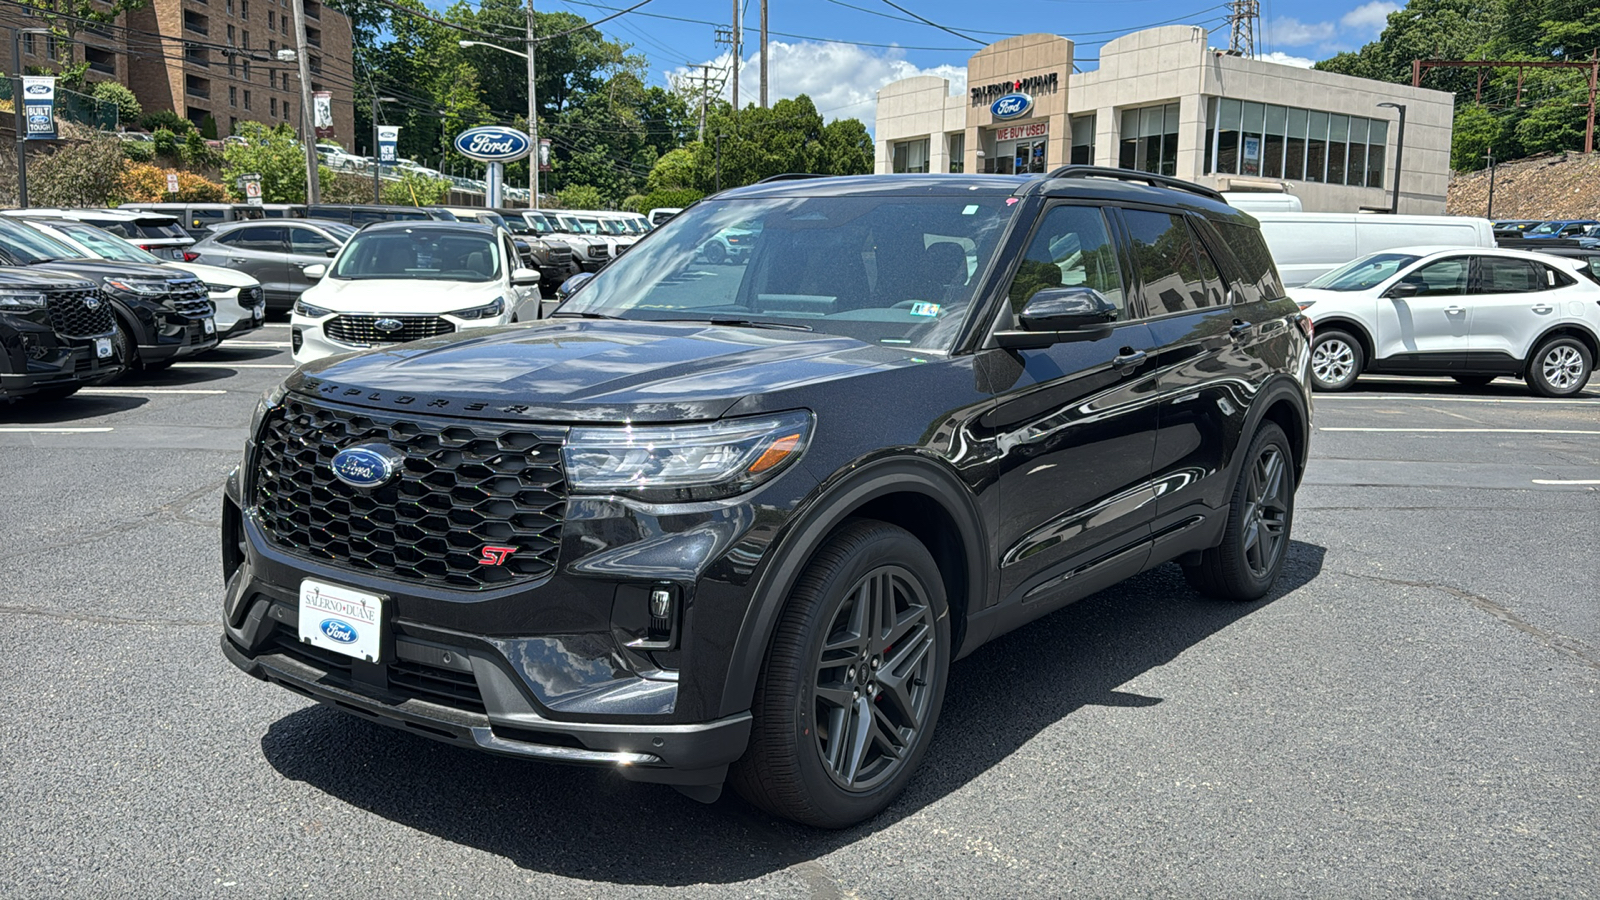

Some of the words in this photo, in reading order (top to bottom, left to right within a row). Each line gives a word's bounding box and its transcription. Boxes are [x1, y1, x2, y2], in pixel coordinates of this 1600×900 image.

[970, 81, 1014, 98] SALERNO
[1022, 72, 1058, 89] DUANE
[29, 107, 49, 115] BUILT
[997, 98, 1021, 114] Ford
[997, 128, 1008, 140] WE
[1010, 126, 1025, 139] BUY
[1026, 123, 1046, 136] USED
[380, 145, 395, 154] NEW
[469, 133, 514, 153] Ford
[381, 153, 395, 161] CARS
[304, 381, 529, 414] EXPLORER
[341, 454, 376, 479] Ford
[478, 545, 517, 566] ST
[305, 593, 342, 612] SALERNO
[346, 603, 375, 621] DUANE
[326, 621, 353, 642] Ford
